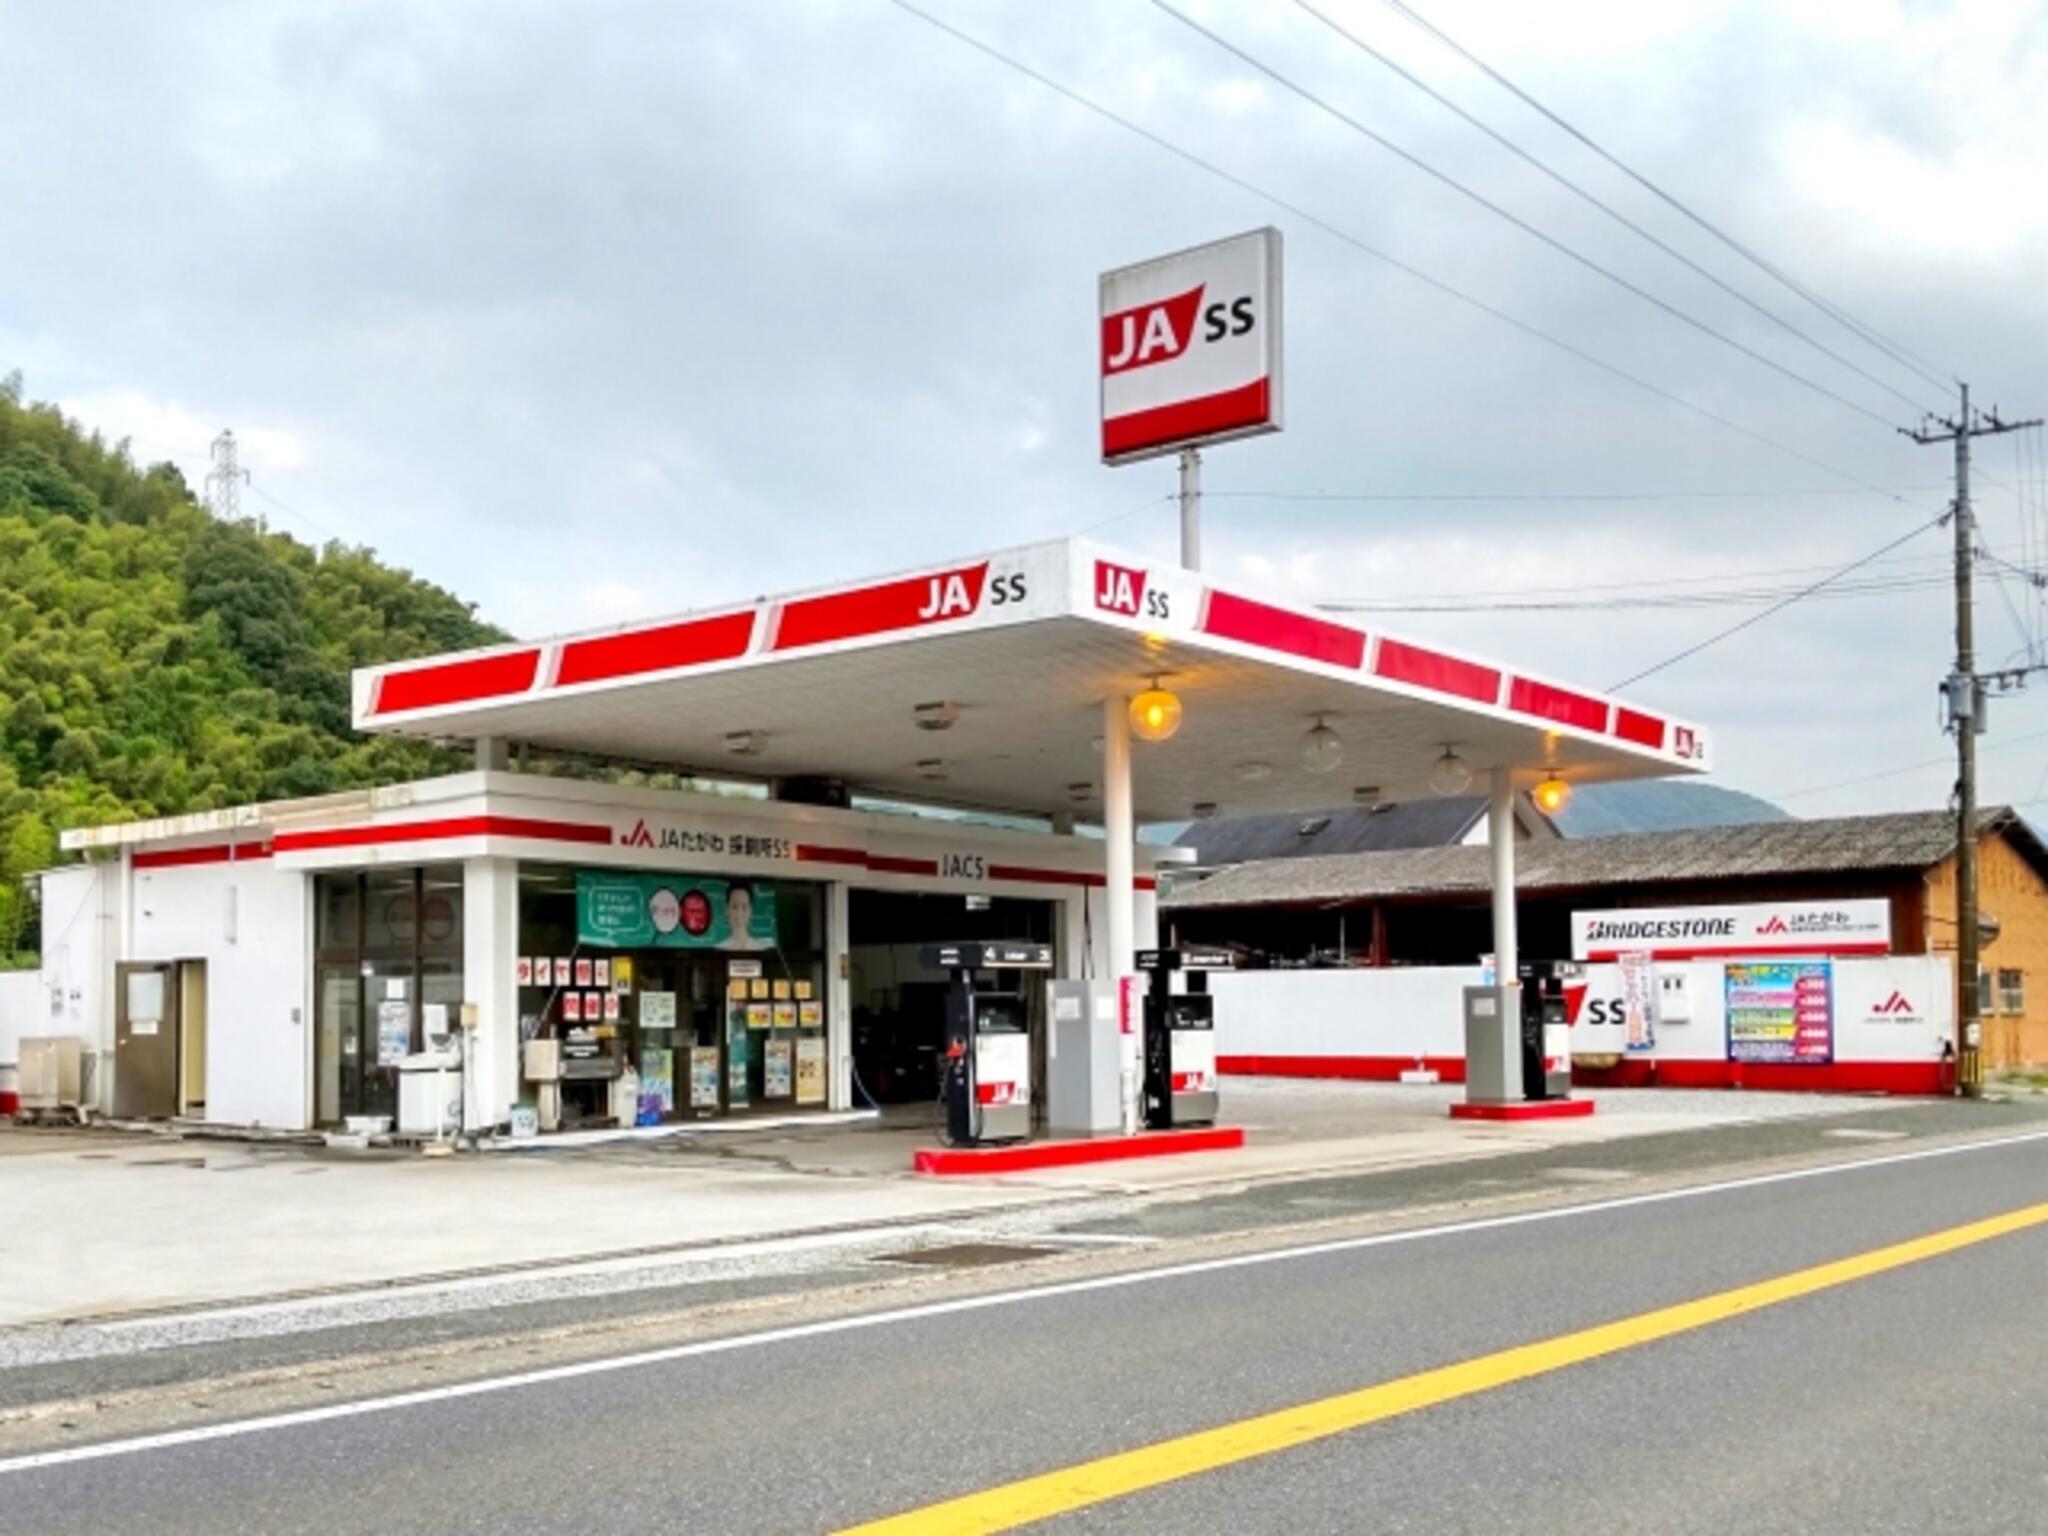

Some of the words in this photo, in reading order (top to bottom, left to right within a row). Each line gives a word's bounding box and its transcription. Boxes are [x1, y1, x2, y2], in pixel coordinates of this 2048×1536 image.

[1107, 306, 1179, 368] JA
[918, 575, 971, 619] JA
[1100, 567, 1136, 612] JA
[1585, 917, 1736, 941] BRIDGESTONE
